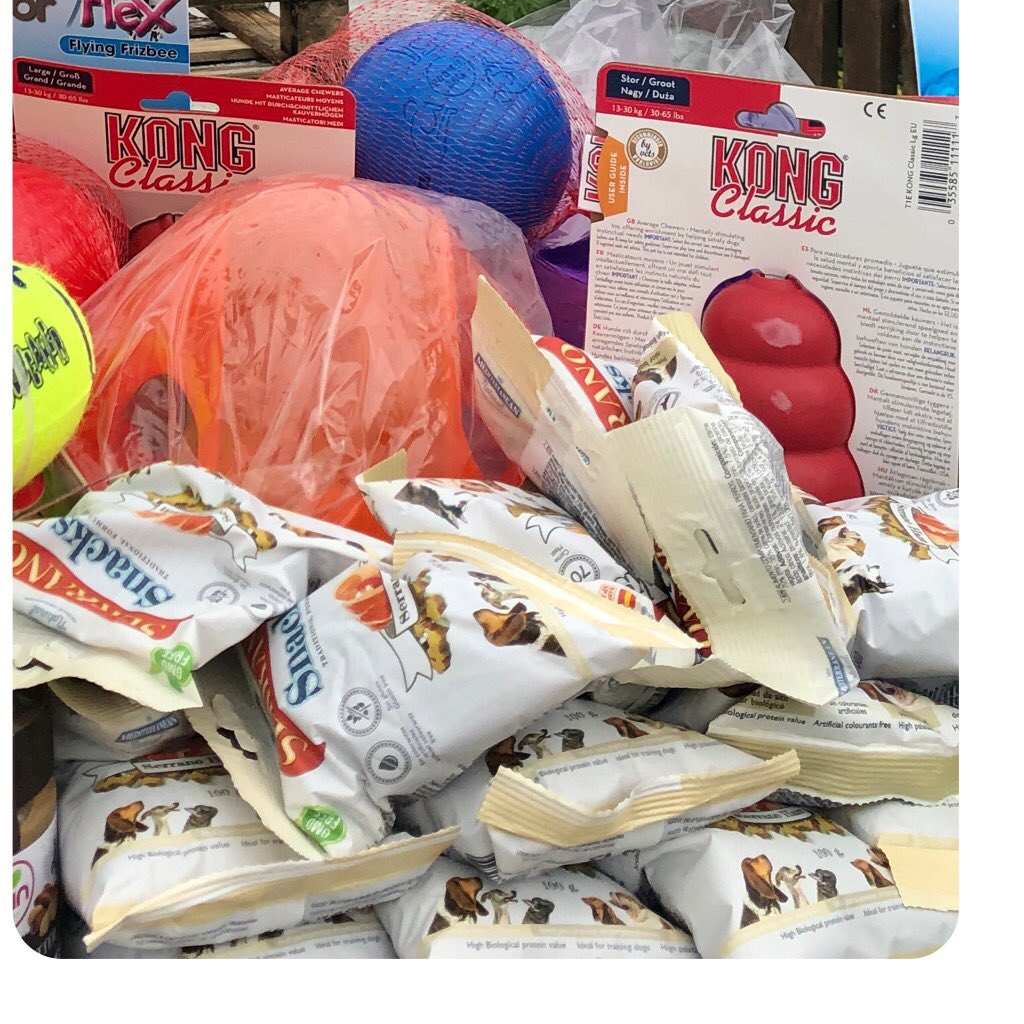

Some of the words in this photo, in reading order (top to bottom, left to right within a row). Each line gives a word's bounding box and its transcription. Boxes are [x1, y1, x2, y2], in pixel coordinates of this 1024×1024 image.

[69, 38, 116, 56] Flying
[121, 41, 178, 58] Frizbee
[28, 65, 51, 76] Large
[23, 73, 49, 84] Grand
[56, 79, 87, 90] Grande
[621, 74, 639, 84] Stor
[649, 78, 676, 88] Groot
[266, 93, 314, 103] MASTICATEURS
[279, 87, 310, 95] AVERAGE
[621, 87, 643, 99] Nagy
[231, 97, 253, 105] HUNDE
[611, 104, 633, 114] 13-30
[634, 107, 643, 116] kg
[650, 109, 672, 118] 30-65
[673, 112, 684, 120] lbs
[283, 116, 326, 125] MASTICATORI
[910, 122, 918, 133] EU
[105, 112, 256, 175] KONG
[641, 139, 651, 153] by
[609, 151, 618, 179] GUIDE
[908, 145, 916, 169] Classic
[109, 156, 233, 193] Classi
[618, 165, 627, 193] INSIDE
[710, 135, 844, 209] KONG
[906, 171, 914, 194] KONG
[608, 181, 617, 204] USER
[710, 184, 837, 236] Classic
[52, 516, 175, 608] Snacks
[118, 537, 169, 580] TRADITIONAL
[564, 711, 585, 721] 100
[757, 713, 785, 722] protein
[787, 716, 806, 725] value
[813, 719, 844, 729] Artificial
[878, 721, 892, 729] free
[898, 722, 913, 731] High
[142, 757, 205, 769] Serrano
[241, 837, 258, 847] Ideal
[542, 880, 564, 891] 100
[466, 941, 484, 950] High
[486, 940, 520, 950] Biological
[522, 941, 547, 950] protein
[577, 941, 592, 949] Ideal
[594, 941, 605, 949] for
[607, 941, 633, 951] training
[634, 943, 651, 952] dogs
